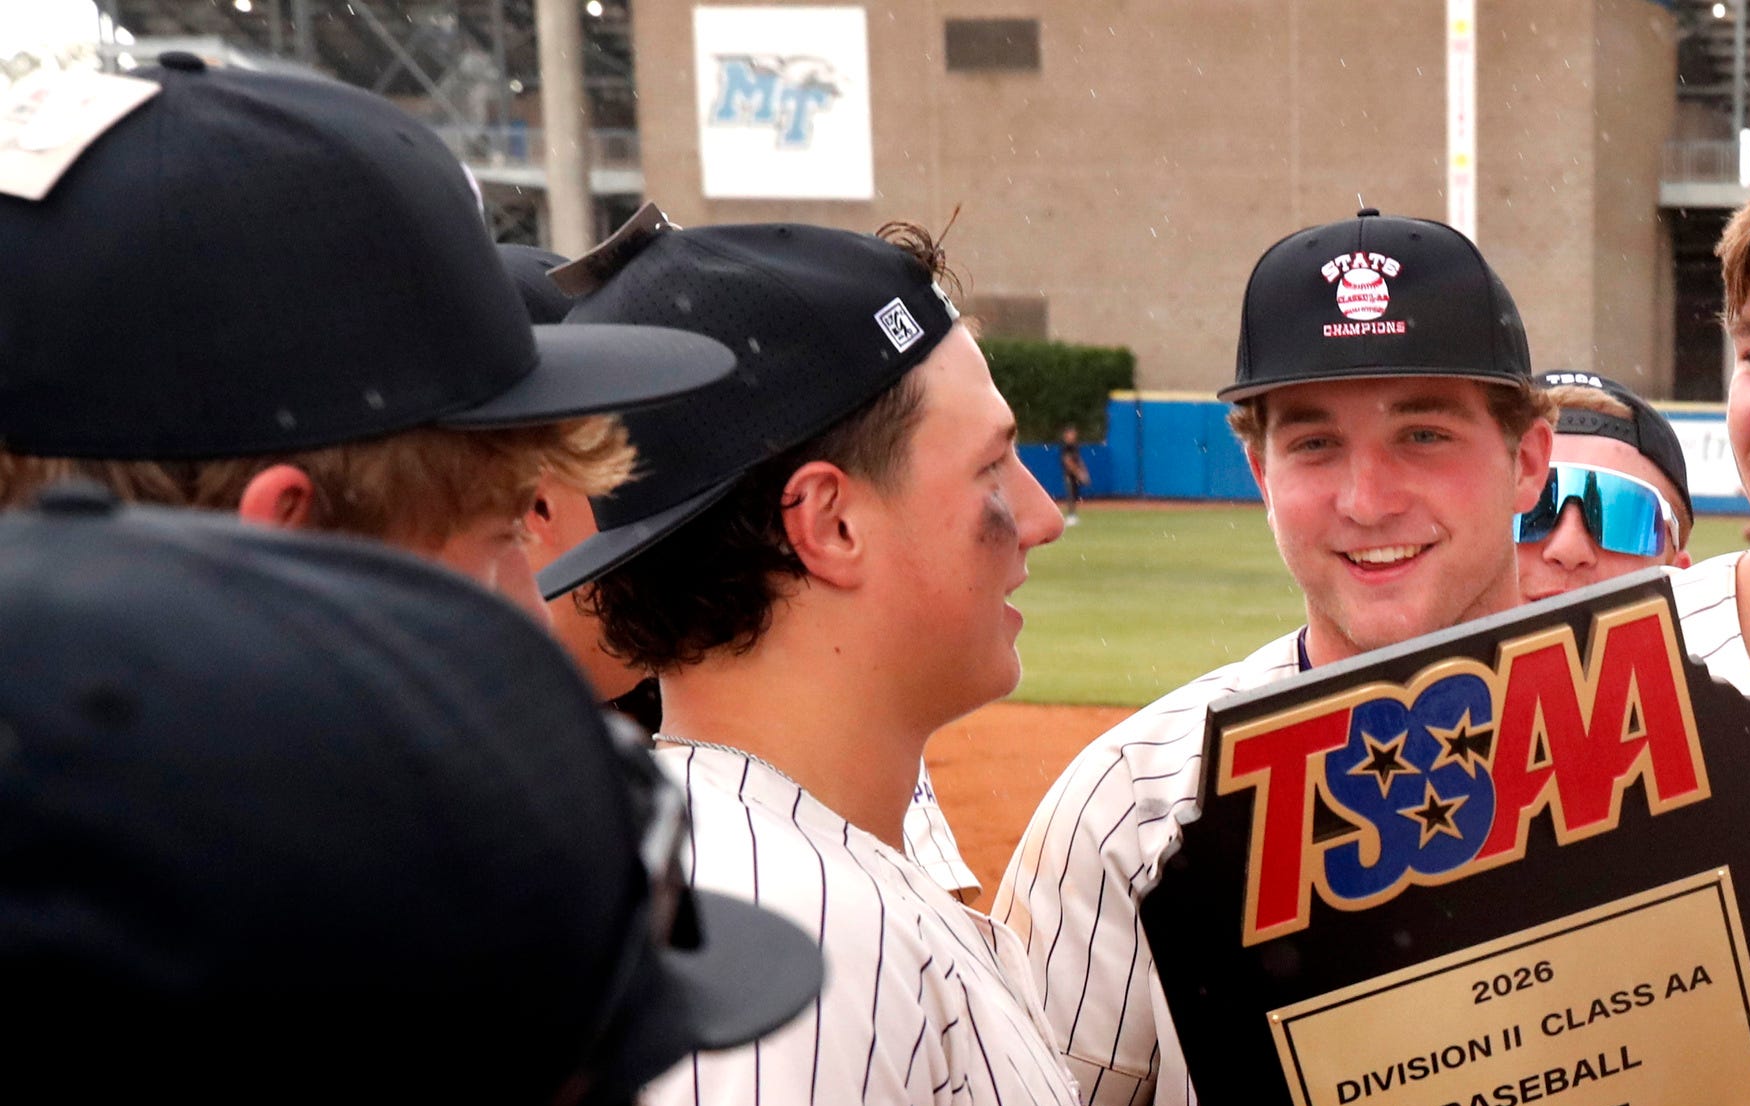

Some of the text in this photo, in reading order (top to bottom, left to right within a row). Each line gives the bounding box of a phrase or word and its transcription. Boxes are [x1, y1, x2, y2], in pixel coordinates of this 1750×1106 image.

[1320, 250, 1402, 284] STATE
[1322, 320, 1407, 338] CHAMPIONS
[1216, 596, 1712, 948] TSSAA
[1471, 960, 1555, 1004] 2026
[1336, 964, 1714, 1105] DIVISION II CLASS AA
